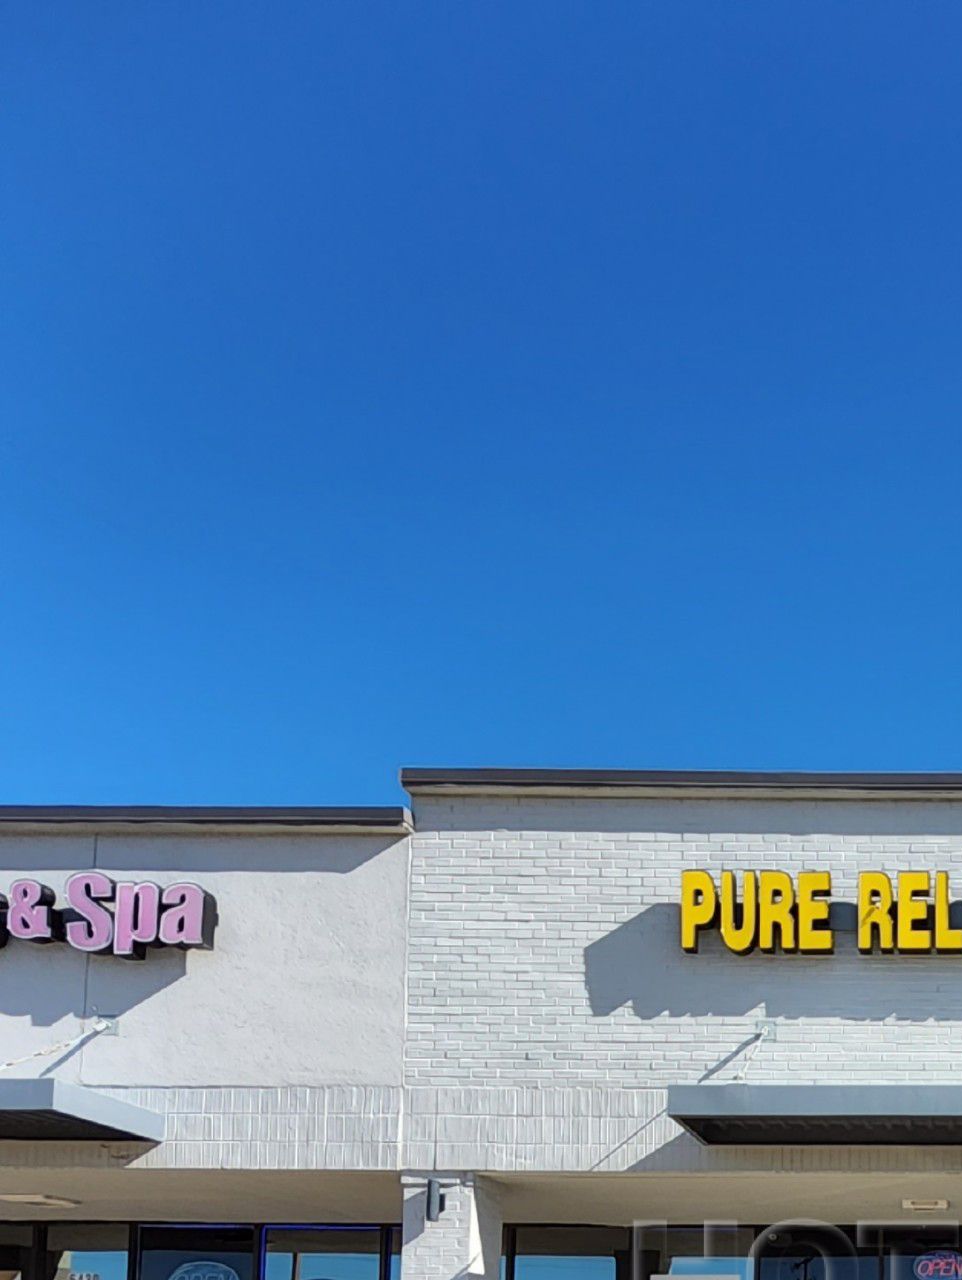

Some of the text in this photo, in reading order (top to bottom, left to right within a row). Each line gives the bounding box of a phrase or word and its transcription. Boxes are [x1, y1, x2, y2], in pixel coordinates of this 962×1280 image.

[7, 871, 205, 955] & Spa
[680, 869, 834, 954] PURE
